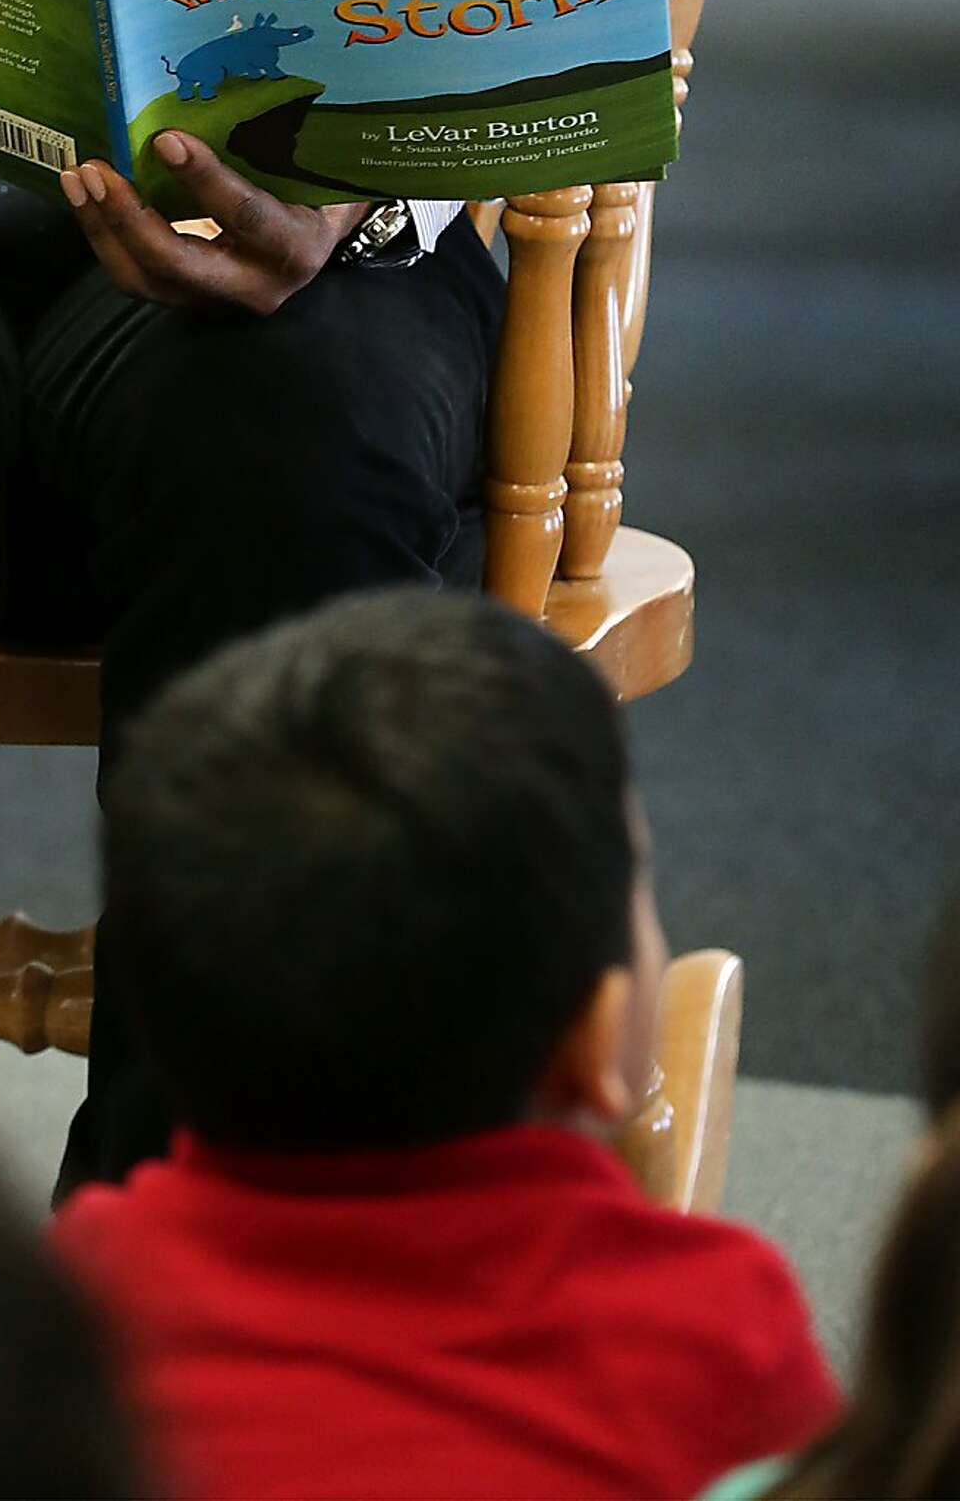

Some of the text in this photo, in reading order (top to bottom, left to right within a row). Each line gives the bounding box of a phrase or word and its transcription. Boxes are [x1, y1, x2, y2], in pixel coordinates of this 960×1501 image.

[361, 111, 599, 142] by LeVar Burton
[406, 144, 451, 153] Susan
[456, 139, 524, 152] Schaefer
[528, 127, 599, 146] Bernardo
[361, 139, 609, 168] Illustrations by Courtenay Fletcher
